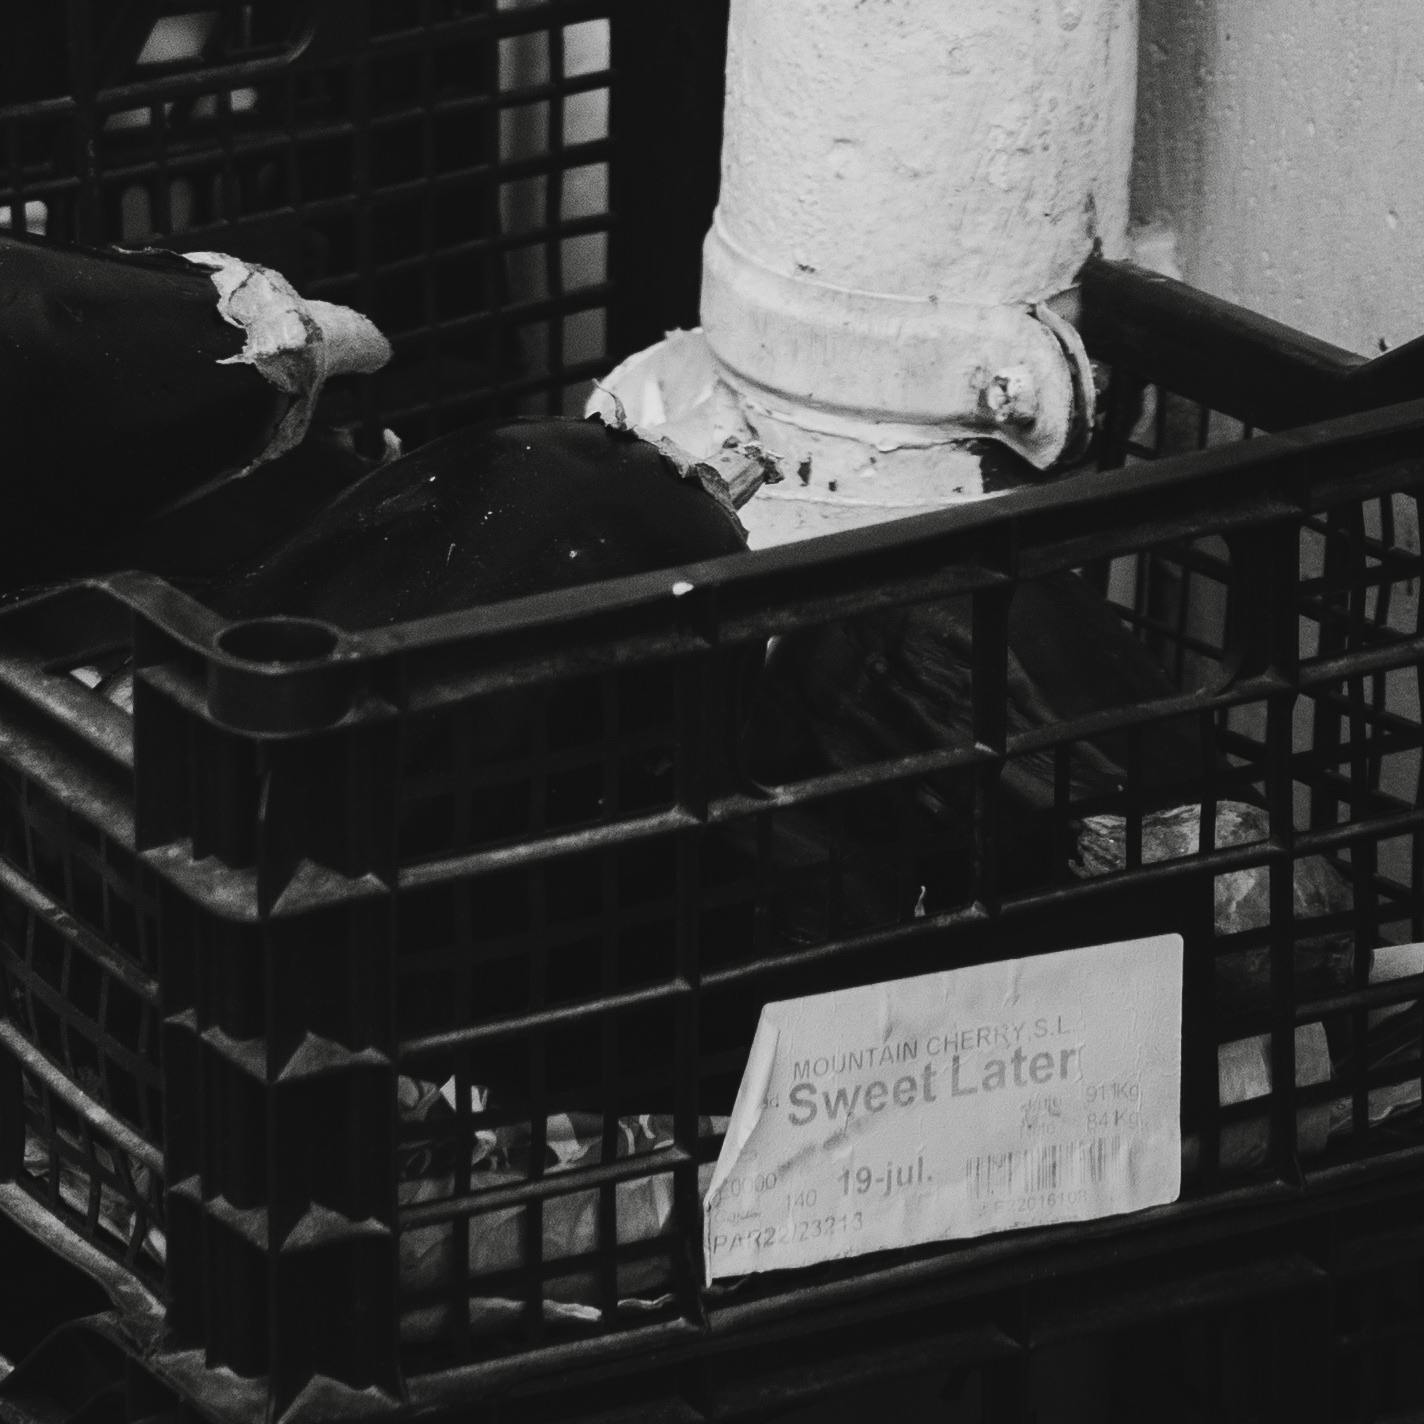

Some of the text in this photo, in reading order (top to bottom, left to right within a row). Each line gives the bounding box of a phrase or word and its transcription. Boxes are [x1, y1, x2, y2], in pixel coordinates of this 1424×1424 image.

[792, 1039, 919, 1081] MOUNTAIN
[787, 1043, 1076, 1127] Sweet Later
[837, 1156, 934, 1196] 19-jul.
